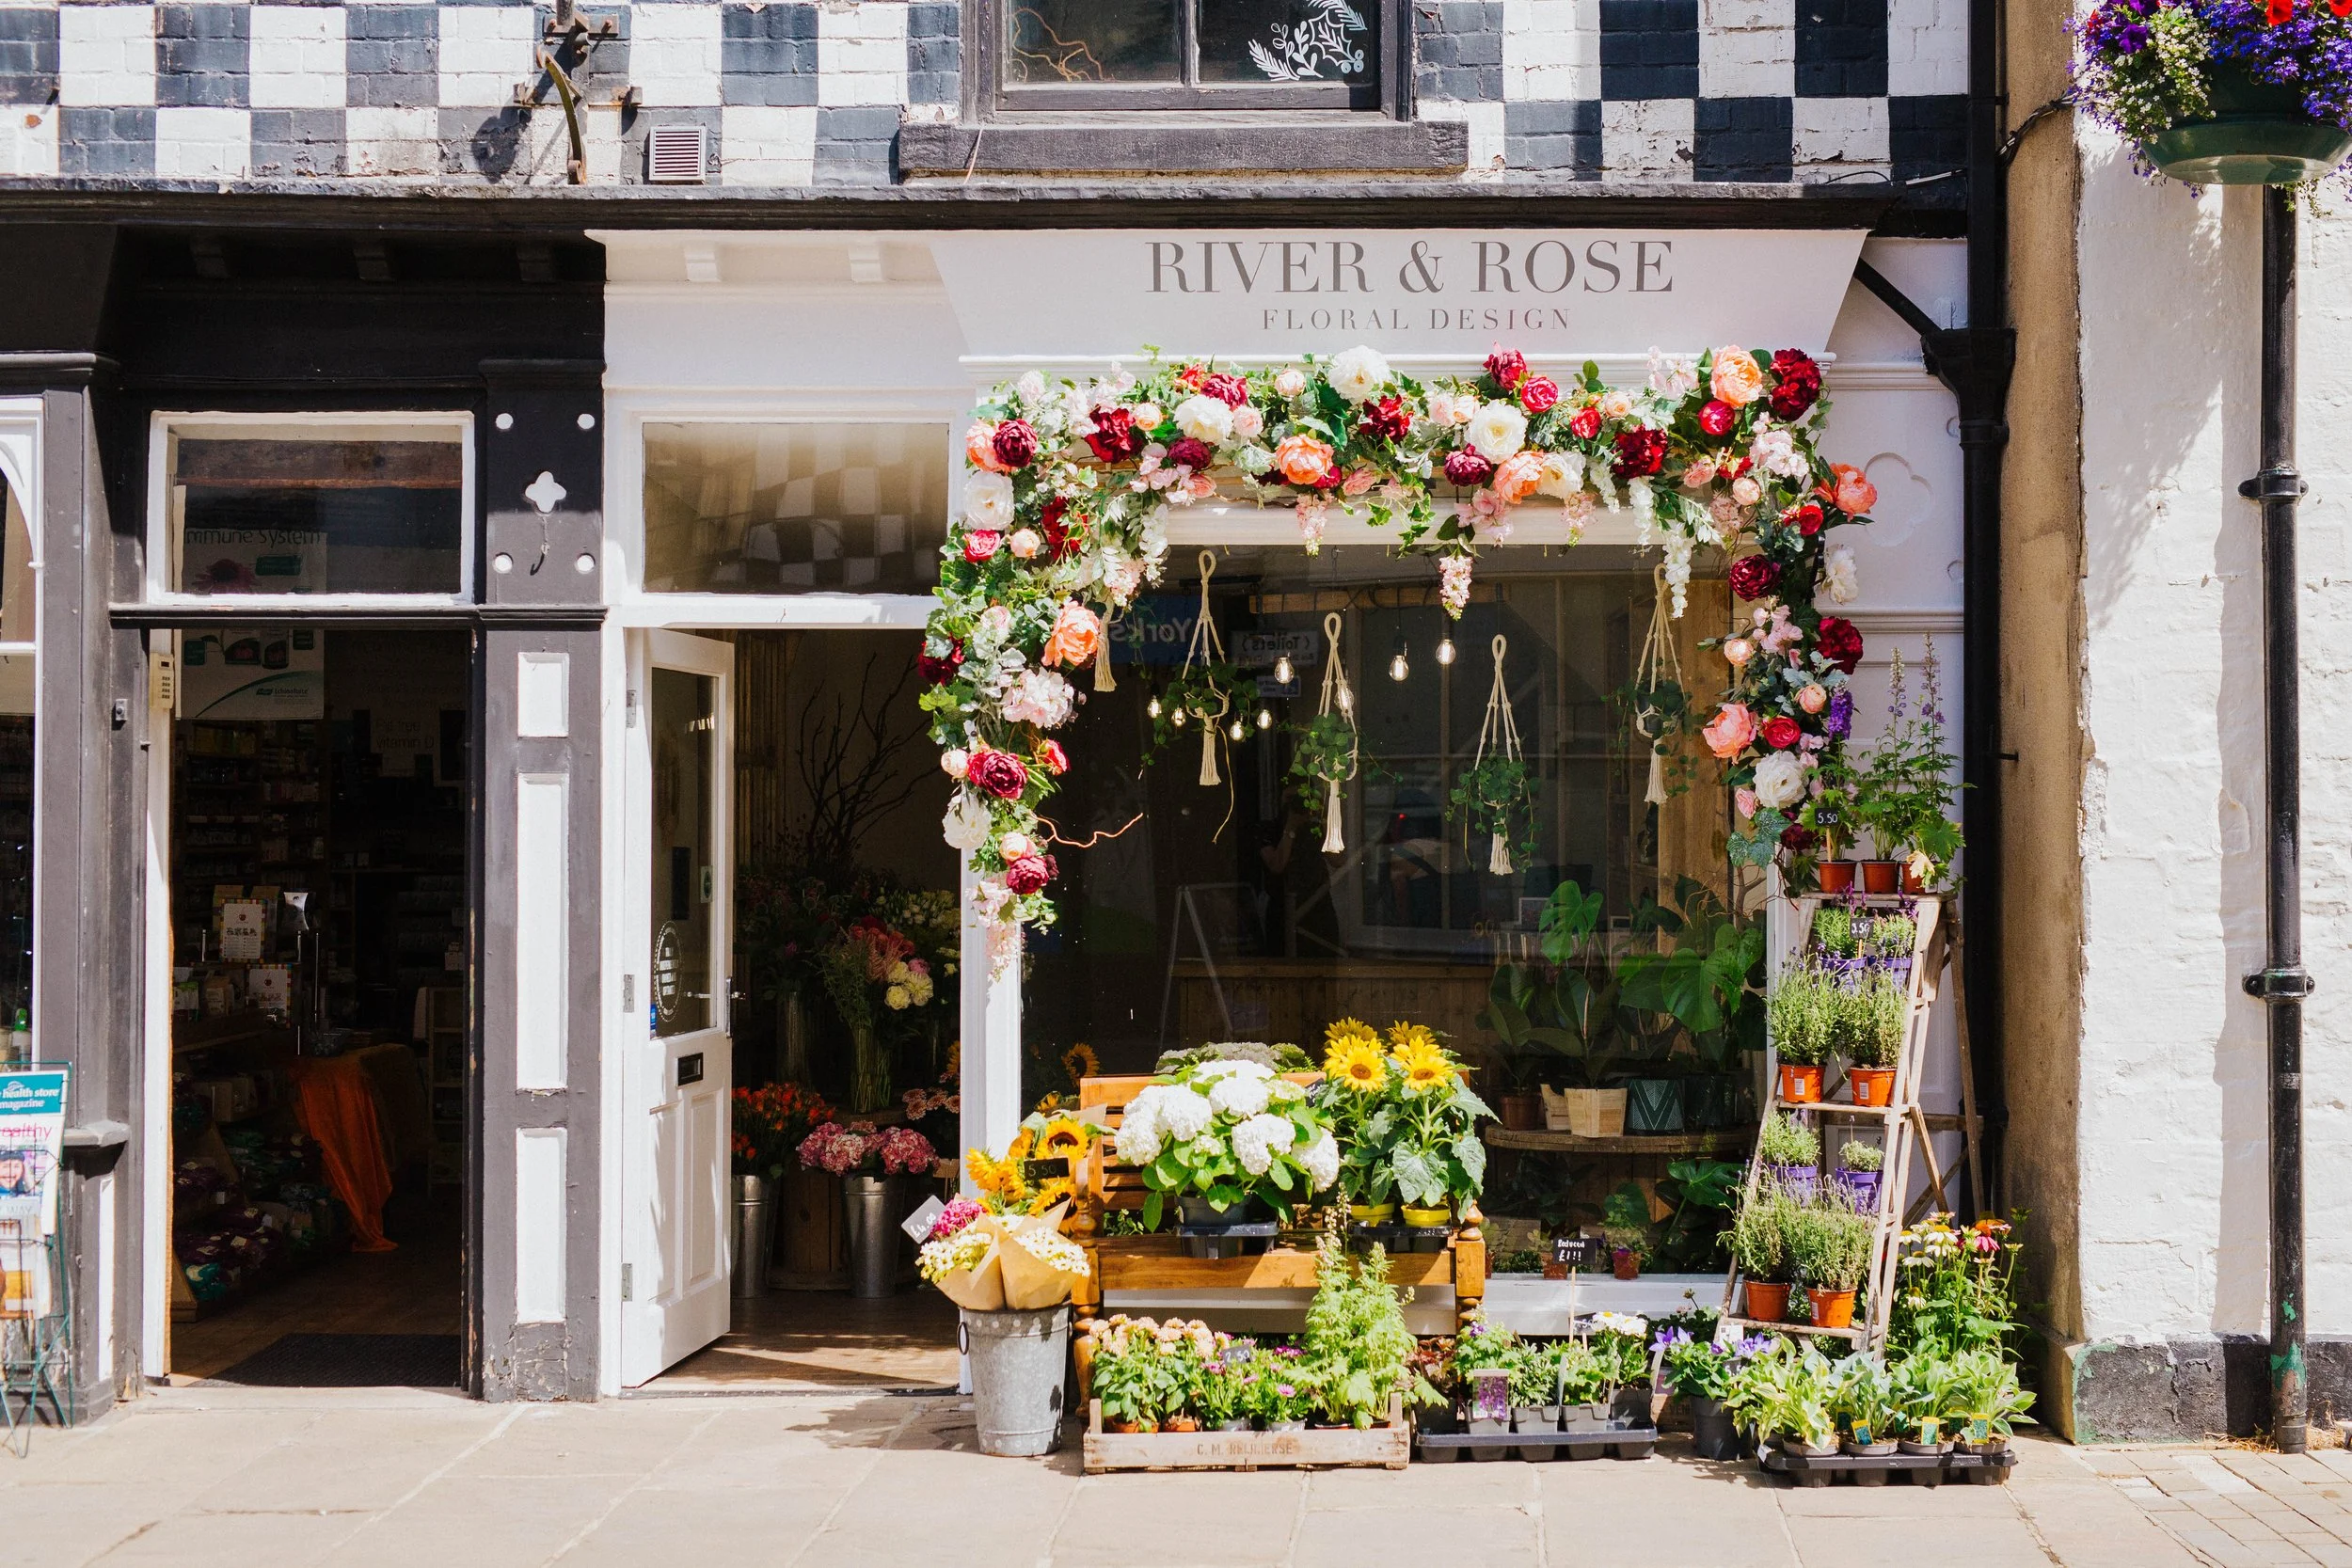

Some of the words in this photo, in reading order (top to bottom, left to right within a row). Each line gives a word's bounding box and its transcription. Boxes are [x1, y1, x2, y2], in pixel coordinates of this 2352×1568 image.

[1144, 241, 1375, 293] RIVER
[1398, 240, 1445, 293] &
[1470, 240, 1673, 293] ROSE
[1263, 309, 1409, 330] FLORAL
[1429, 309, 1570, 330] DESIGN
[186, 530, 253, 544] mmune
[2, 1086, 34, 1099] health
[34, 1087, 60, 1098] store
[2, 1122, 53, 1141] ealthy
